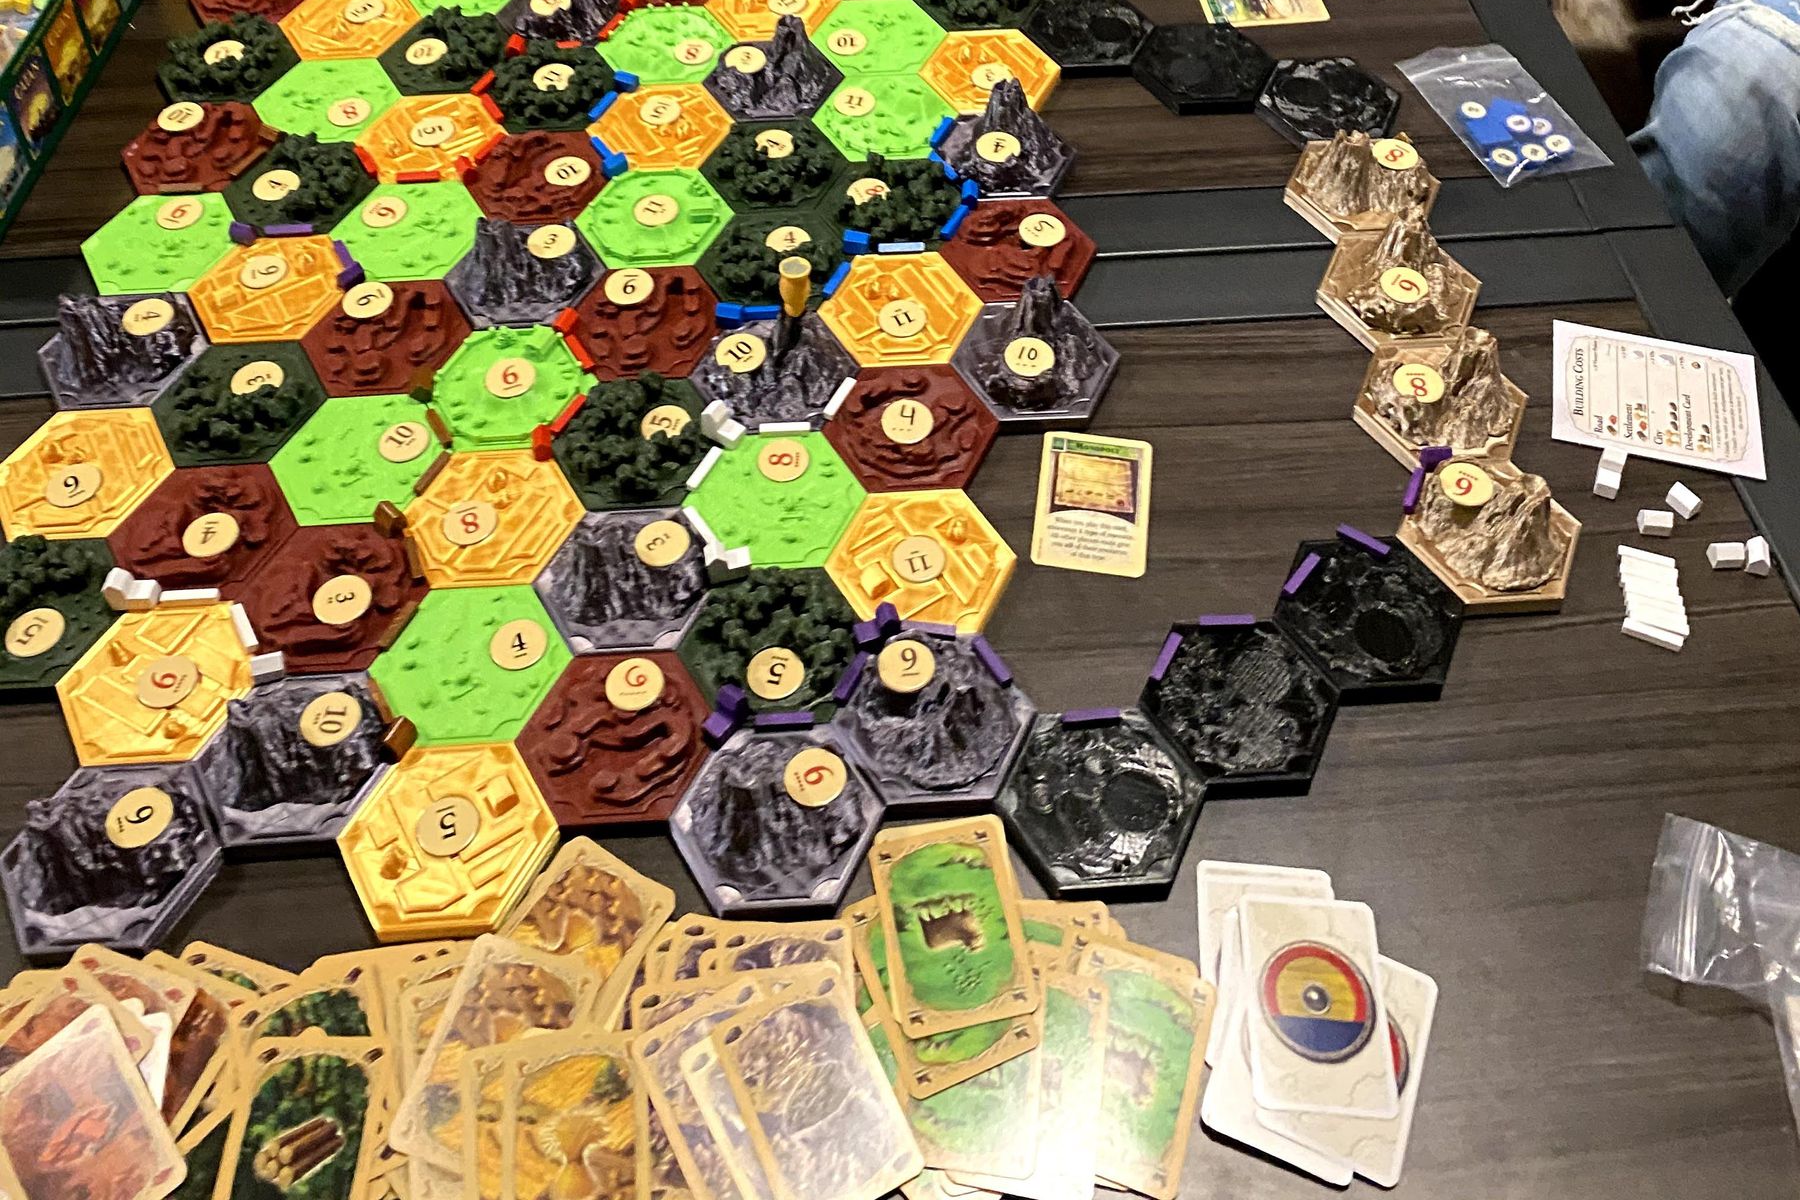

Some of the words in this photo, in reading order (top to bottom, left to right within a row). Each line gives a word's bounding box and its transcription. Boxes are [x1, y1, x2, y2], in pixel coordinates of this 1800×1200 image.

[837, 37, 856, 47] 10
[845, 95, 863, 106] 11
[1385, 148, 1404, 163] 8
[557, 164, 580, 180] 10
[545, 233, 559, 245] 3
[891, 311, 915, 327] 11
[727, 341, 753, 362] 10
[1018, 346, 1038, 361] 10
[247, 375, 265, 387] 3
[502, 364, 519, 385] 6
[1410, 377, 1428, 397] 8
[651, 414, 673, 430] 5
[900, 405, 916, 425] 4
[1594, 415, 1603, 433] Road
[386, 425, 414, 447] 10
[768, 452, 793, 466] 8
[460, 512, 480, 533] 8
[199, 530, 217, 545] 4
[646, 536, 666, 552] 3
[904, 554, 933, 574] 11
[335, 591, 355, 604] 3
[16, 623, 40, 646] 5
[512, 632, 527, 652] 4
[767, 662, 786, 685] 5
[319, 705, 348, 734] 10
[439, 811, 457, 840] 5
